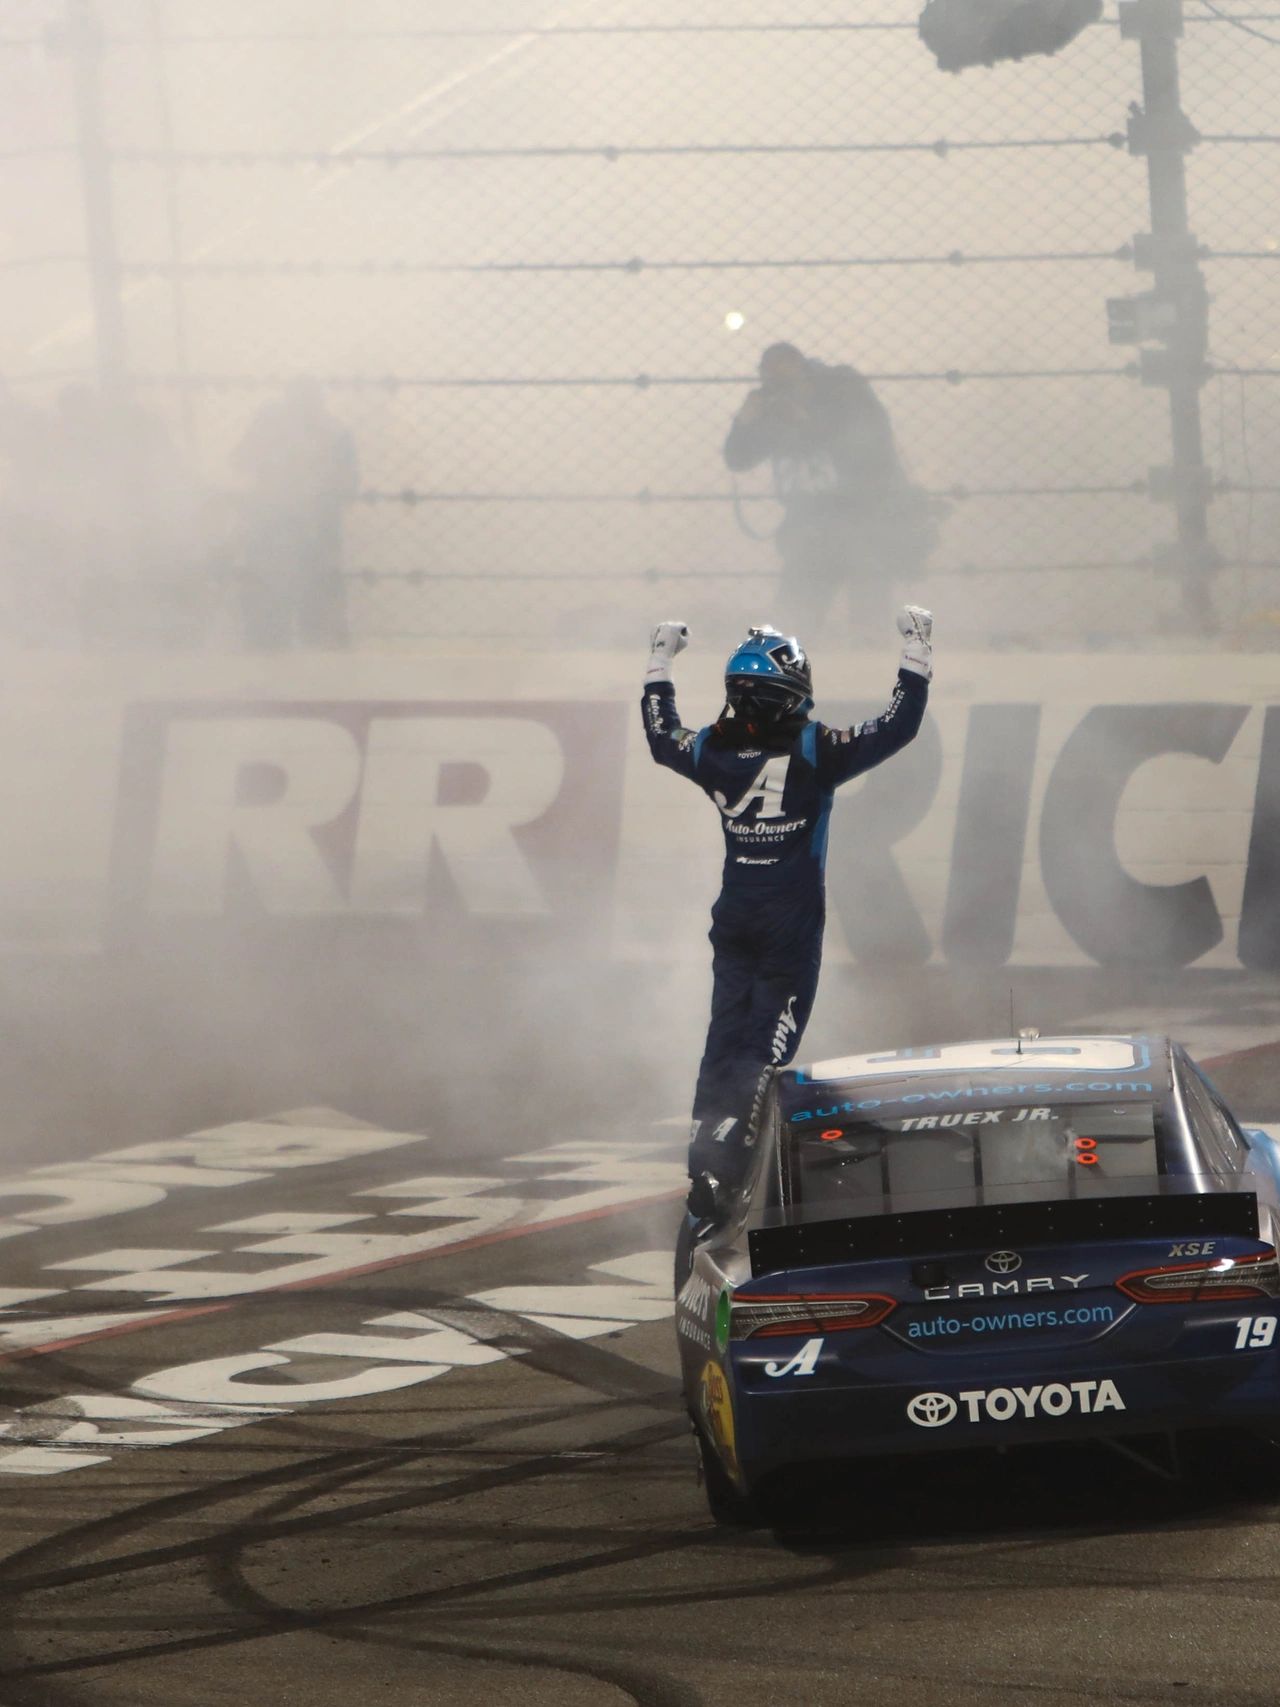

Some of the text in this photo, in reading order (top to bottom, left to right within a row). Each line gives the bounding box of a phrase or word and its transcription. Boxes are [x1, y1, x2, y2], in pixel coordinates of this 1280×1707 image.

[714, 754, 791, 819] A
[147, 715, 564, 915] RR
[726, 818, 807, 836] Auto-Owners
[736, 834, 785, 844] INSURANCE
[790, 1079, 1153, 1123] auto-owners.com
[901, 1106, 1060, 1132] TRUEX JR.
[1167, 1241, 1217, 1257] XSE
[923, 1273, 1090, 1301] CAMRY
[907, 1302, 1114, 1339] auto-owners.com
[1234, 1315, 1278, 1350] 19
[958, 1379, 1127, 1423] TOYOTA
